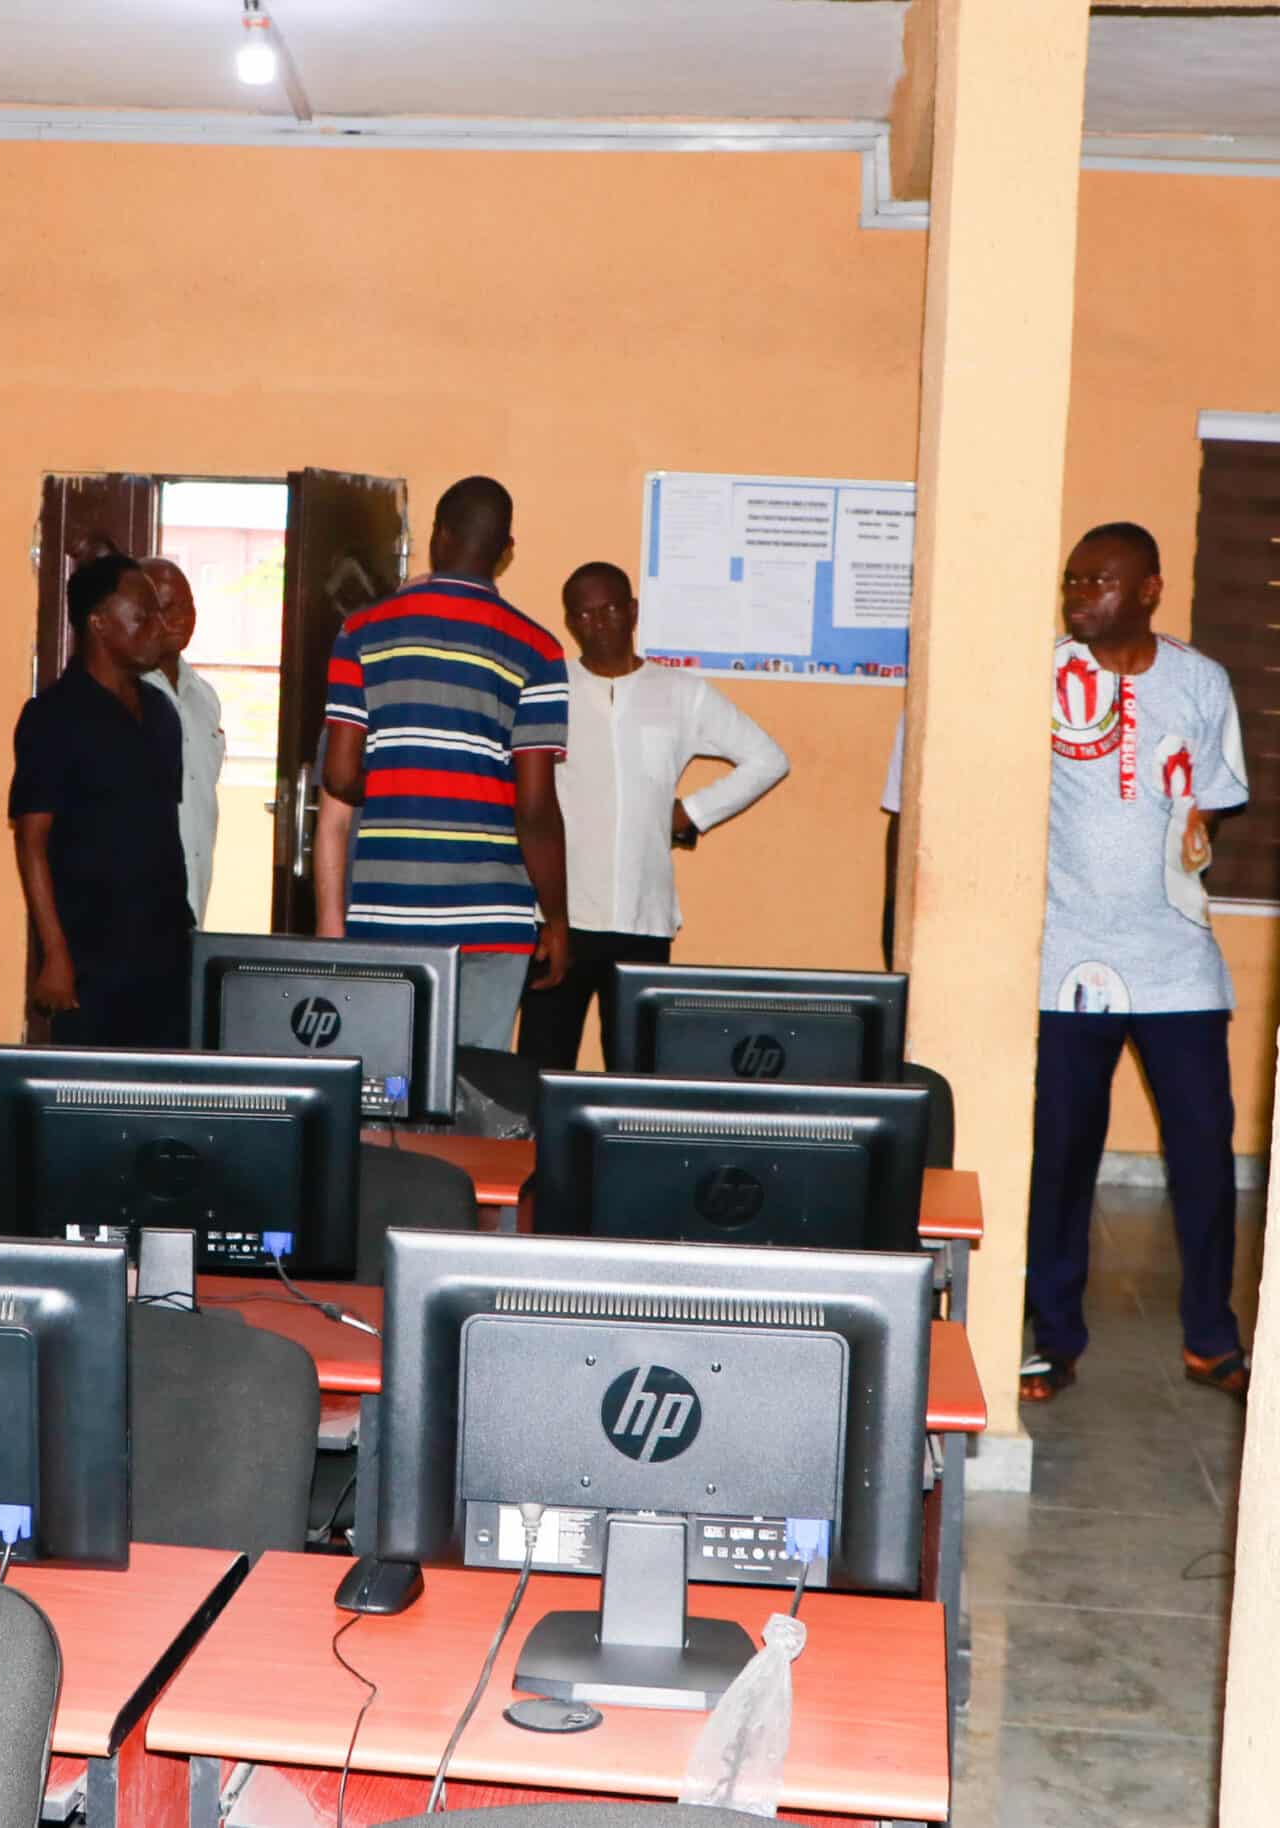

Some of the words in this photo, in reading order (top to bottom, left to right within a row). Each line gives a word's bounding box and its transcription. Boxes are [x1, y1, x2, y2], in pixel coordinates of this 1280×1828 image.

[1122, 698, 1136, 719] OF
[1122, 723, 1136, 773] JESUS
[298, 997, 336, 1048] hp
[738, 1036, 780, 1080] hp
[612, 1365, 694, 1462] hp
